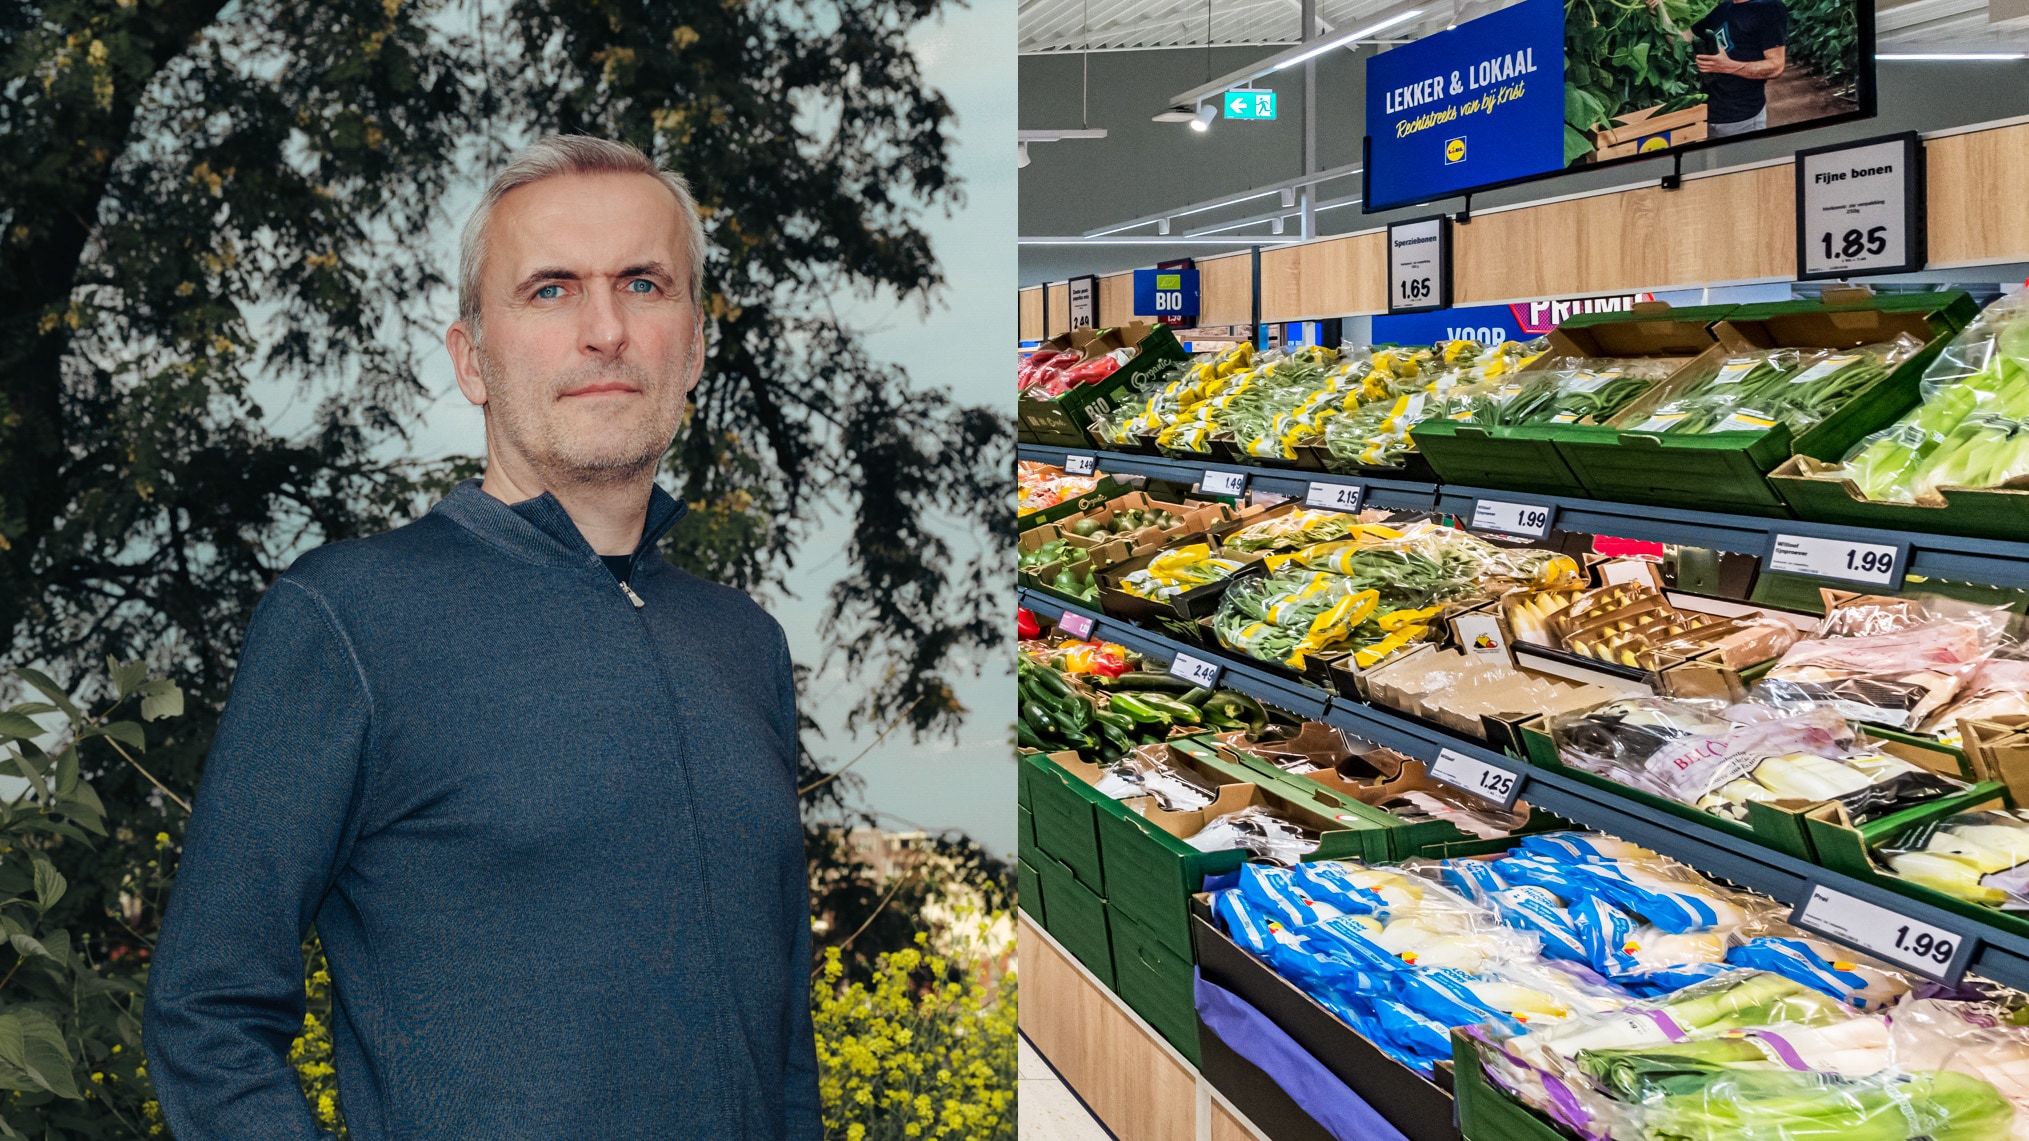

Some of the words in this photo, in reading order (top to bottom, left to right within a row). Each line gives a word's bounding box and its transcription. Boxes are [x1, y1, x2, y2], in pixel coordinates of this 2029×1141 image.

[1386, 76, 1444, 114] LEKKER
[1449, 70, 1463, 95] &
[1470, 47, 1537, 90] LOKAAL
[1396, 104, 1457, 138] Rechtstreeks
[1460, 99, 1480, 116] van
[1481, 89, 1496, 115] bij
[1497, 80, 1525, 105] Krist
[1815, 171, 1847, 185] Fijne
[1851, 165, 1893, 179] bonen
[1394, 235, 1437, 248] Sperziebonen
[1821, 226, 1887, 259] 1.85
[1401, 277, 1431, 299] 1.65
[1155, 292, 1182, 311] BIO
[1131, 358, 1172, 389] Organic
[1225, 476, 1242, 490] 1.49
[1337, 489, 1359, 505] 2.15
[1518, 510, 1546, 528] 1.99
[1847, 549, 1893, 574] 1.99
[1193, 664, 1215, 682] 2.49
[1480, 770, 1513, 795] 1.25
[1814, 893, 1829, 903] Prei
[1895, 925, 1953, 964] 1.99
